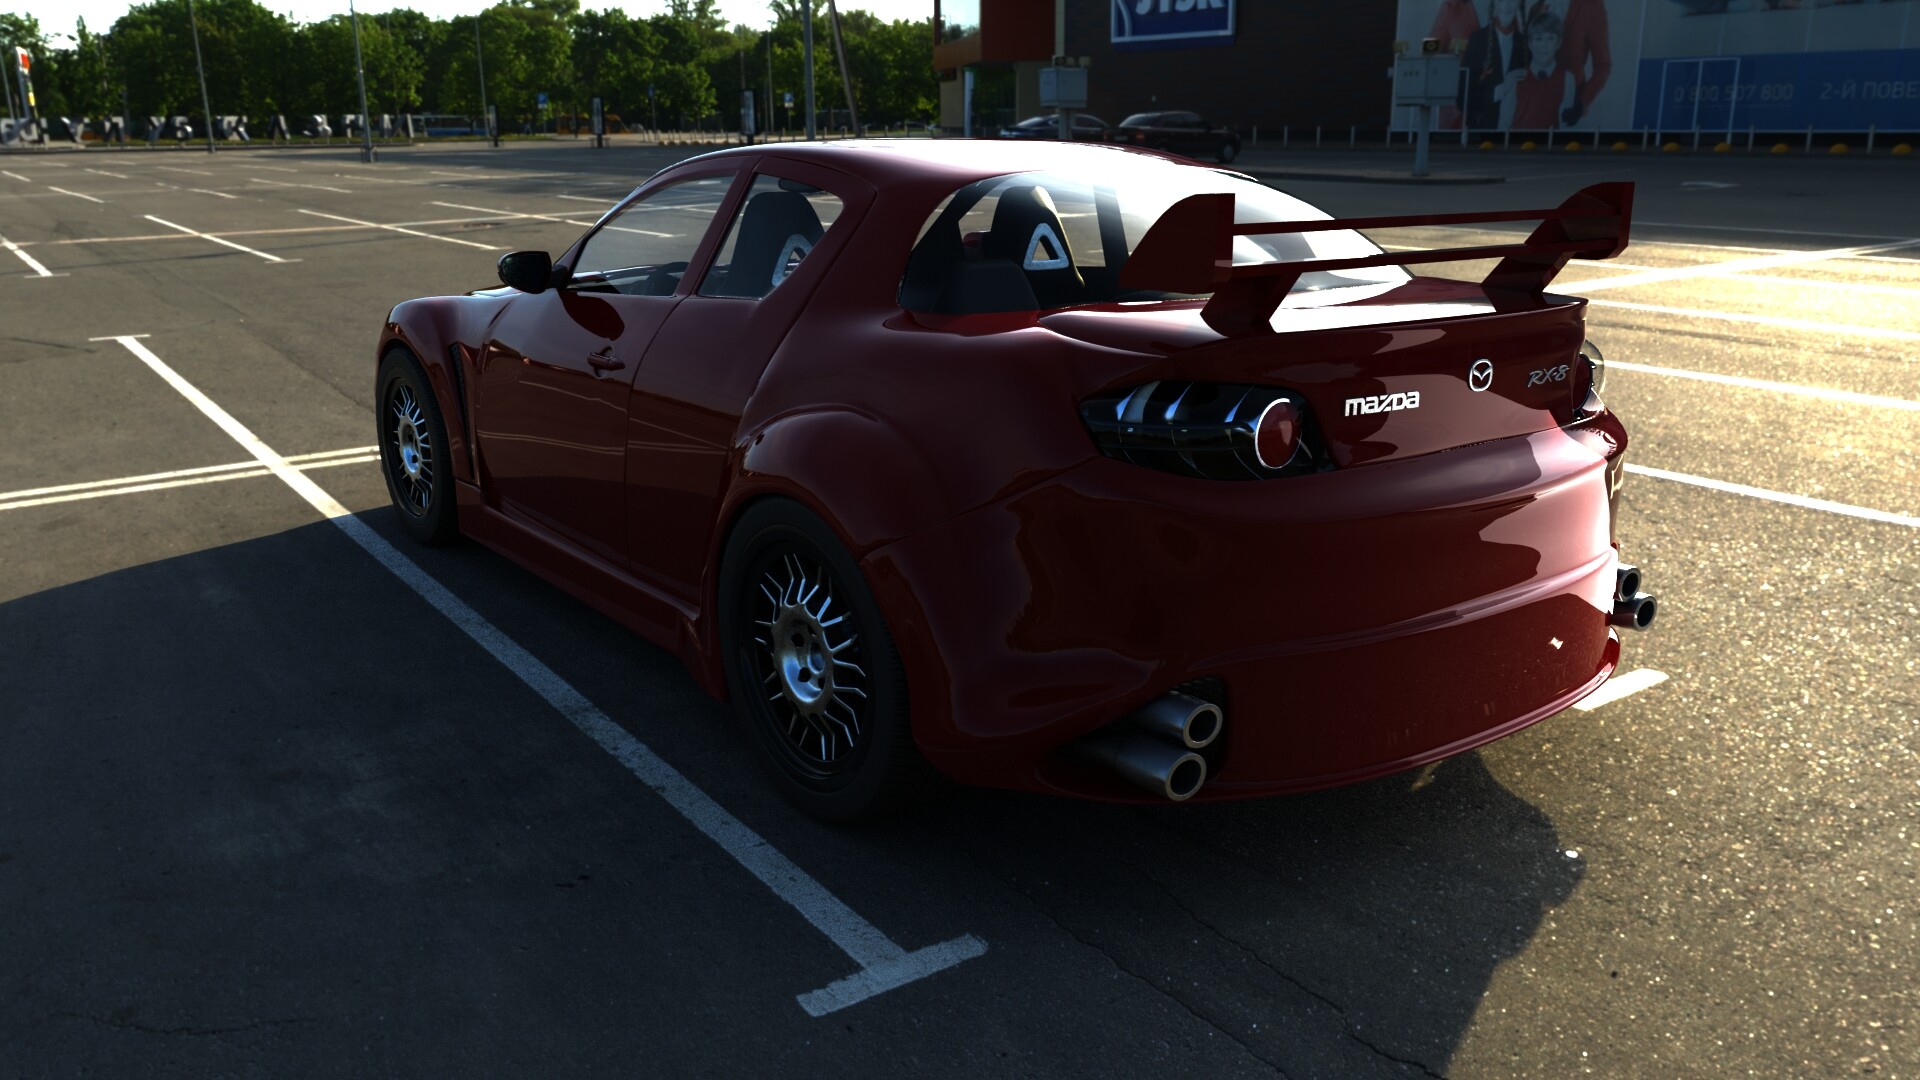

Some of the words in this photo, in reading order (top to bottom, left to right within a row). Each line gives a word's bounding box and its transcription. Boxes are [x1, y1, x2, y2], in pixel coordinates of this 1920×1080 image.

[1673, 85, 1684, 103] 0
[1760, 83, 1794, 101] 800
[1527, 364, 1570, 388] RX-8
